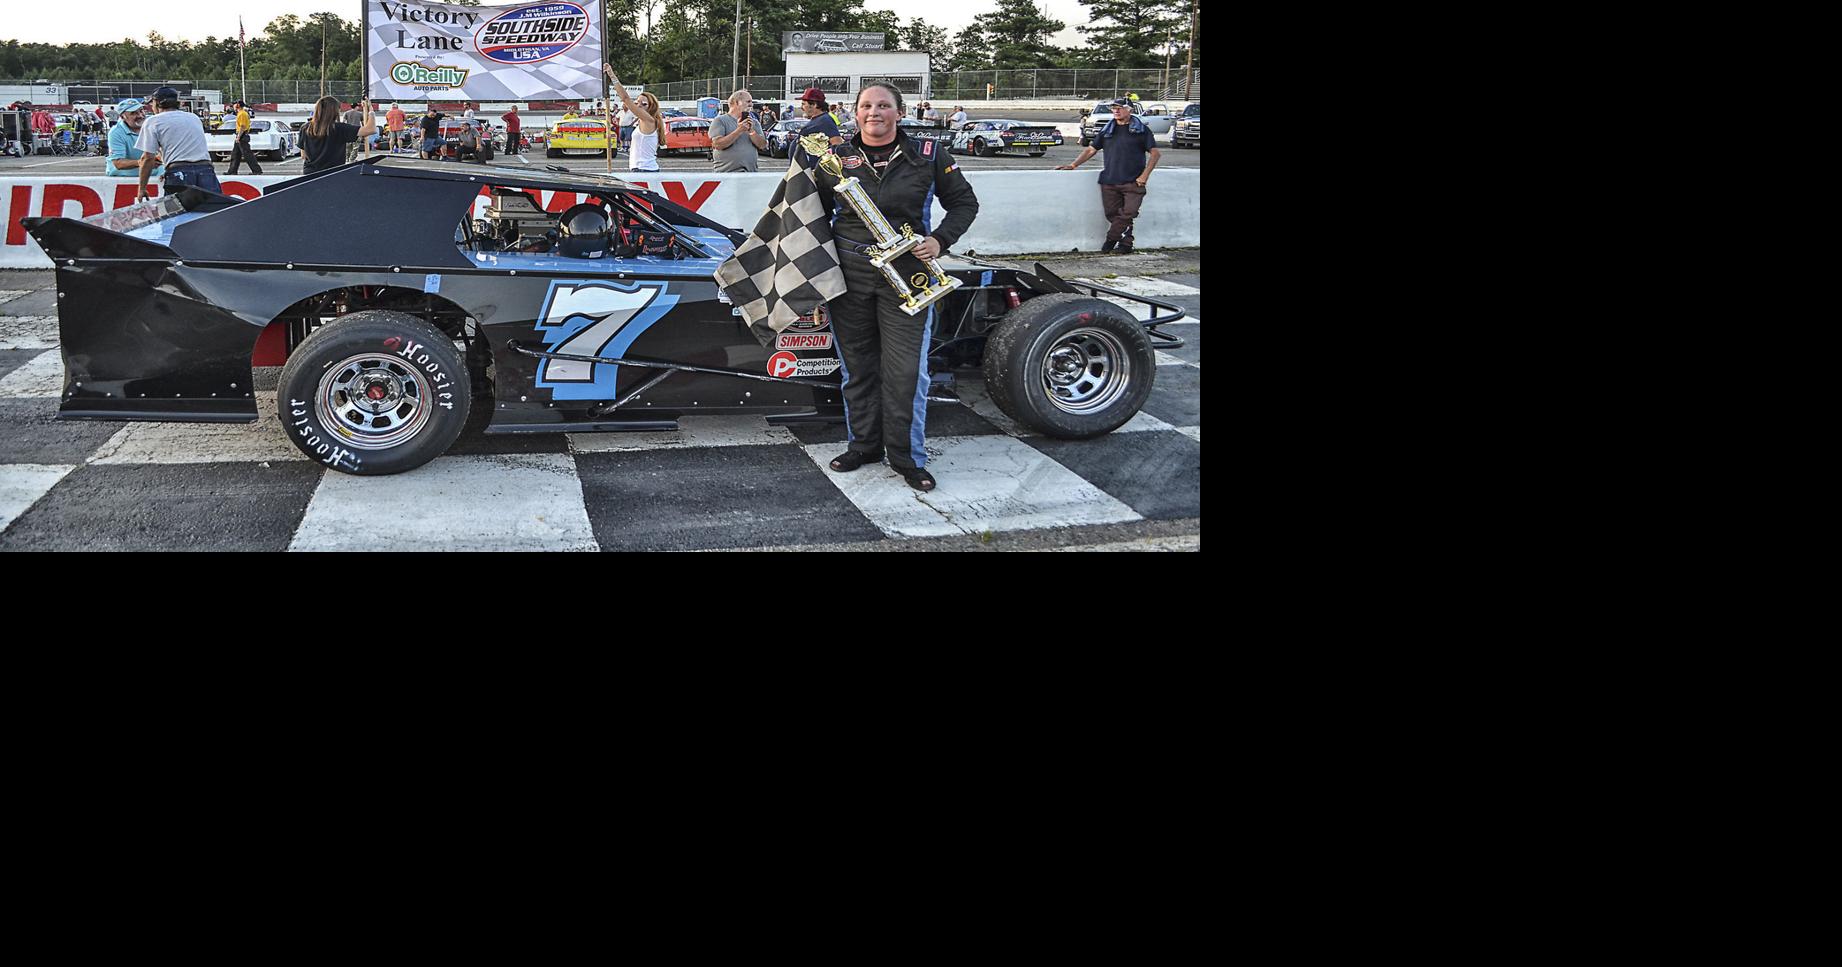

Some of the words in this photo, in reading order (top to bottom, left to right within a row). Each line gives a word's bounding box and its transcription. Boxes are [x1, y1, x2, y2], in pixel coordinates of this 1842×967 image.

[379, 2, 479, 29] Victory
[485, 16, 586, 35] SOUTHSIDE
[397, 30, 463, 50] Lane
[482, 32, 580, 44] SPEEDWAY
[513, 51, 541, 59] USA
[394, 64, 464, 84] O'Reilly
[952, 132, 969, 149] 22
[536, 280, 672, 390] 7
[780, 335, 828, 347] SIMPSON
[796, 359, 840, 368] Competition
[397, 340, 453, 410] Hoosier
[291, 398, 350, 466] Hoosier
